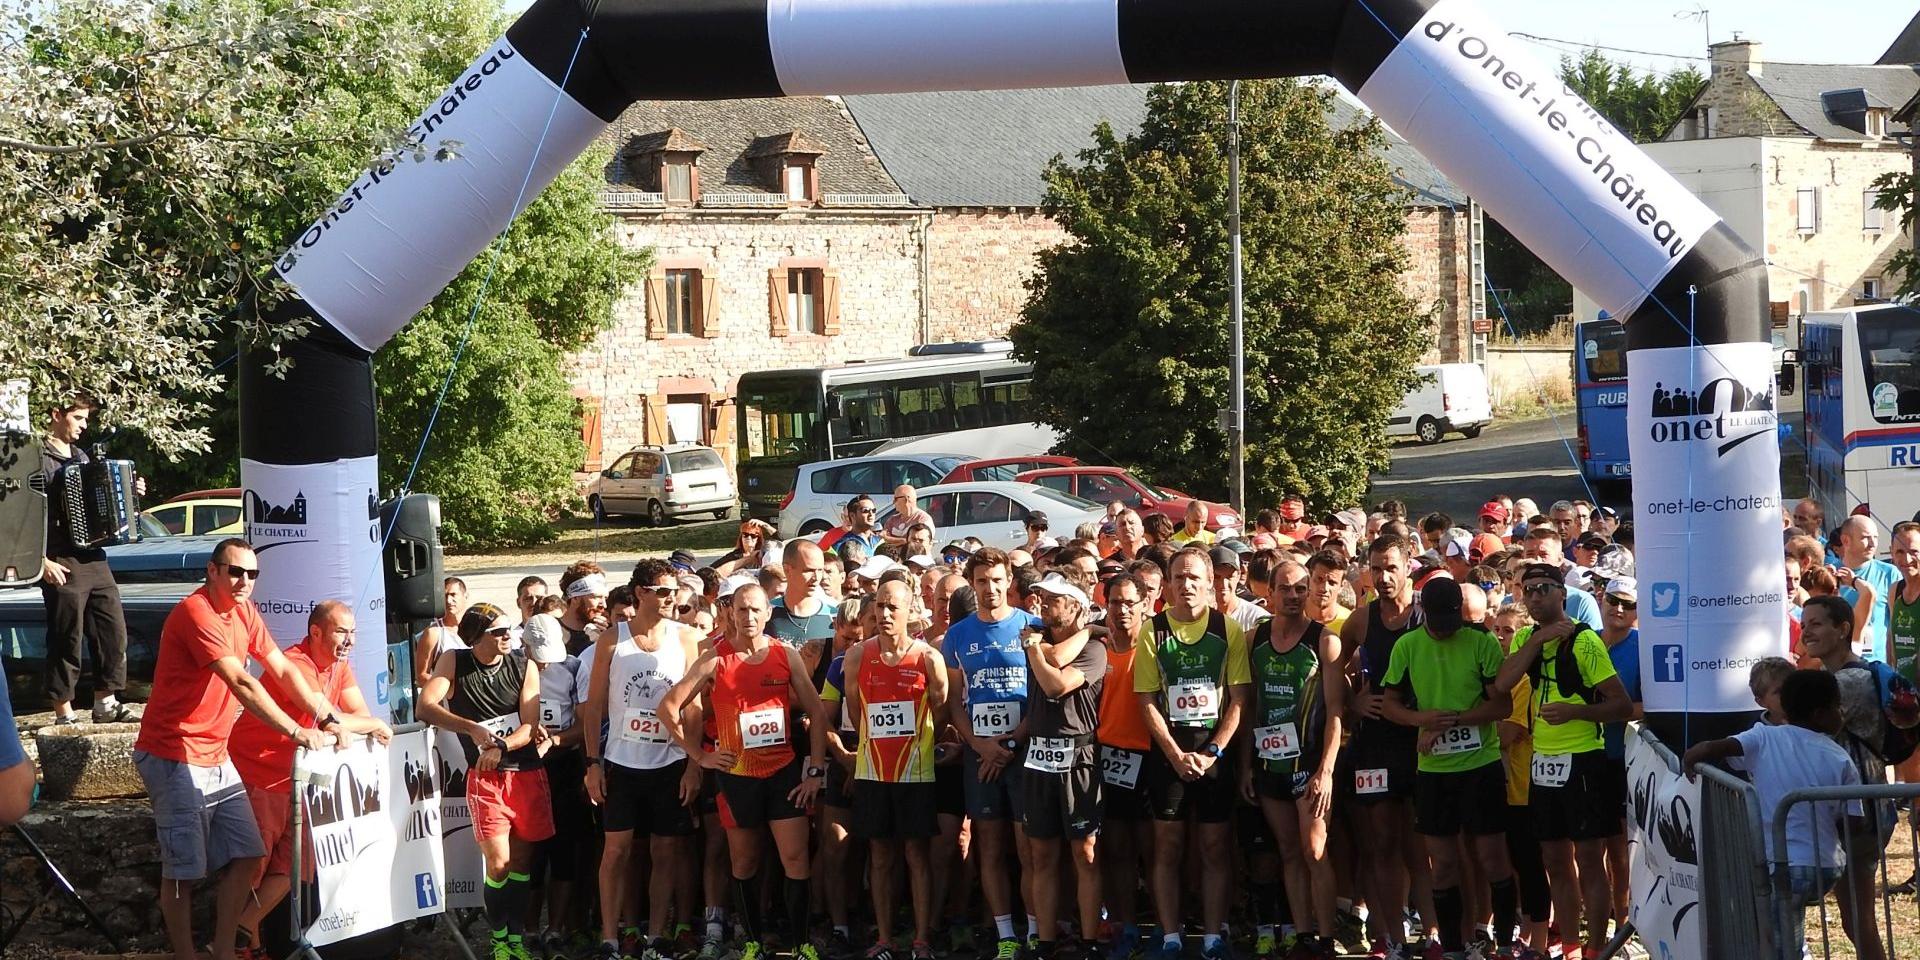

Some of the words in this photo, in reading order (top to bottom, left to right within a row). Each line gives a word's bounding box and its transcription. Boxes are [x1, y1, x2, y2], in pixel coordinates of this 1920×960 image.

[1597, 392, 1628, 405] RUB
[1650, 410, 1728, 443] onet
[264, 527, 307, 538] CHATEAU
[1176, 694, 1209, 710] 039
[630, 718, 660, 735] 021
[869, 712, 905, 728] 1031
[748, 721, 780, 737] 028
[1261, 734, 1289, 750] 061
[1356, 773, 1384, 790] 011
